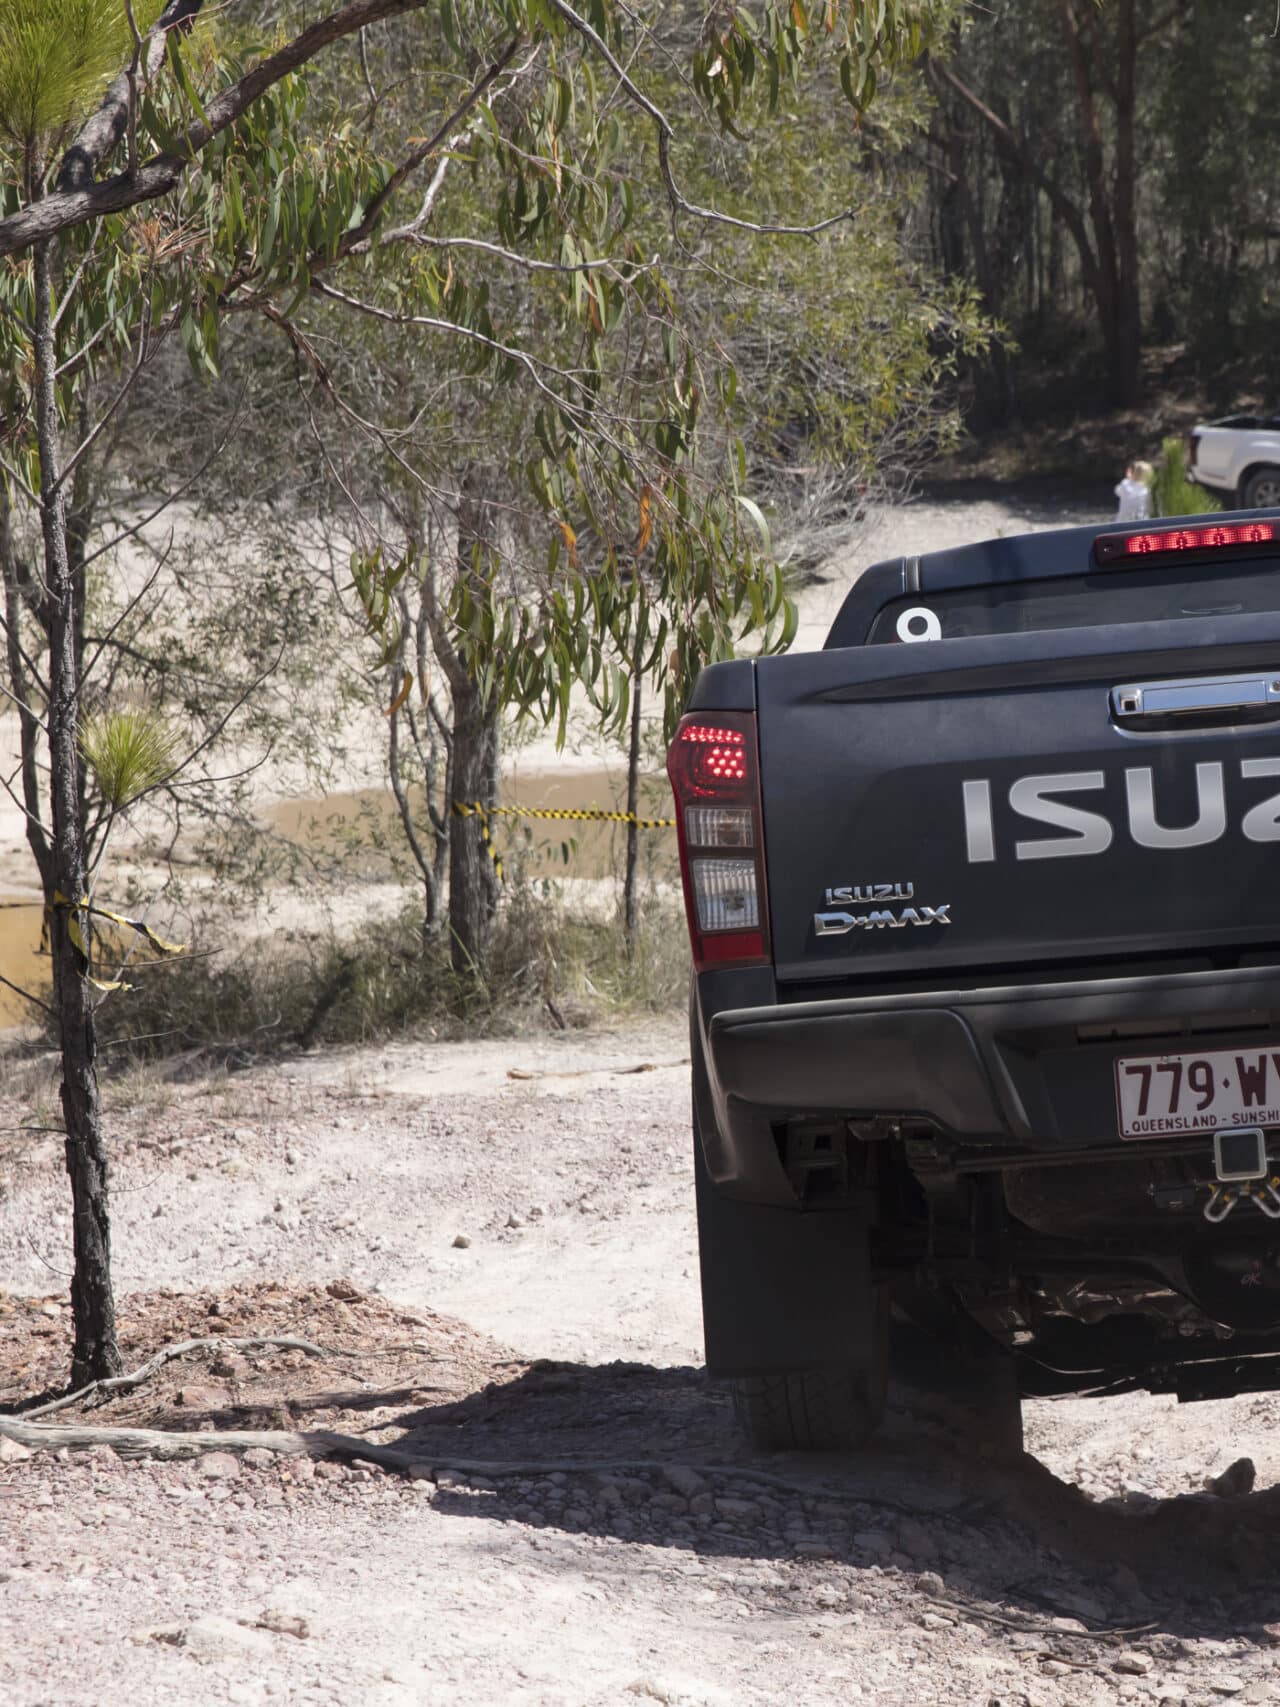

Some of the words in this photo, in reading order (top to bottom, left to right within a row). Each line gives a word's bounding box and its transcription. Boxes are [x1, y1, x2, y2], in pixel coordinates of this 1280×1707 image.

[825, 882, 914, 905] ISUZU
[814, 904, 951, 936] D-MAX
[1132, 1113, 1217, 1133] QUEENSLAND
